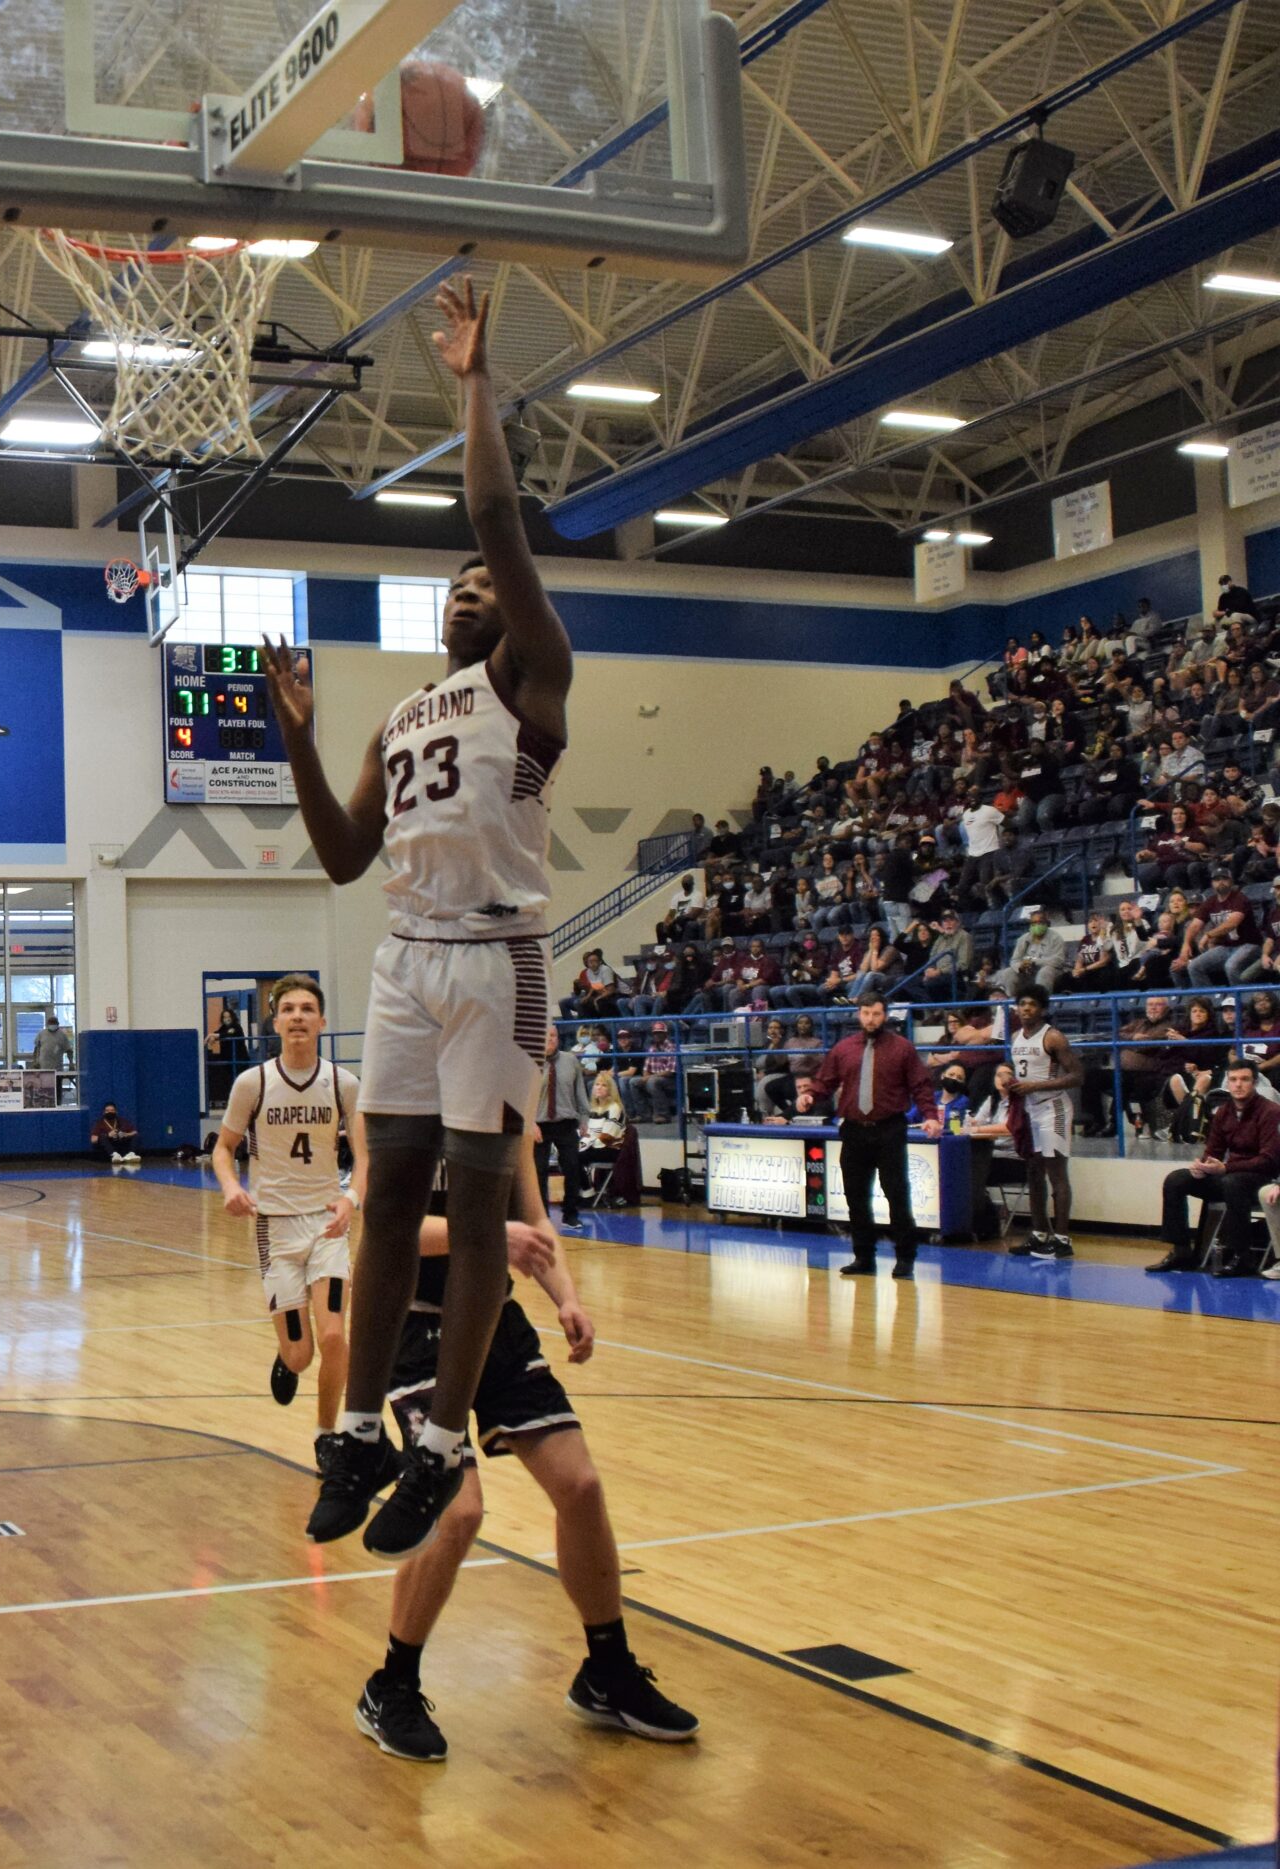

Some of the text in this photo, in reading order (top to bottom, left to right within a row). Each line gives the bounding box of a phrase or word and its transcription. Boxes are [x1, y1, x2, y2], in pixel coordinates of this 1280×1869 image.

[230, 11, 338, 151] ELITE 9600
[174, 675, 206, 687] HOME
[227, 684, 254, 692] PERIOD
[178, 690, 209, 714] 71
[234, 696, 247, 713] 4
[170, 717, 194, 727] FOULS
[218, 719, 267, 729] PLAYER FOUL
[177, 728, 192, 746] 4
[170, 750, 194, 759] SCORE
[229, 752, 256, 760] MATCH
[211, 766, 275, 775] ACE PAINTING
[387, 735, 460, 817] 23
[208, 779, 278, 788] CONSTRUCTION
[1019, 1059, 1028, 1078] 3
[266, 1105, 332, 1126] GRAPELAND
[290, 1132, 313, 1165] 4
[710, 1152, 802, 1185] FRANKSTON
[806, 1161, 825, 1174] POSS
[712, 1184, 746, 1209] HIGH
[748, 1186, 800, 1215] SCHOOL
